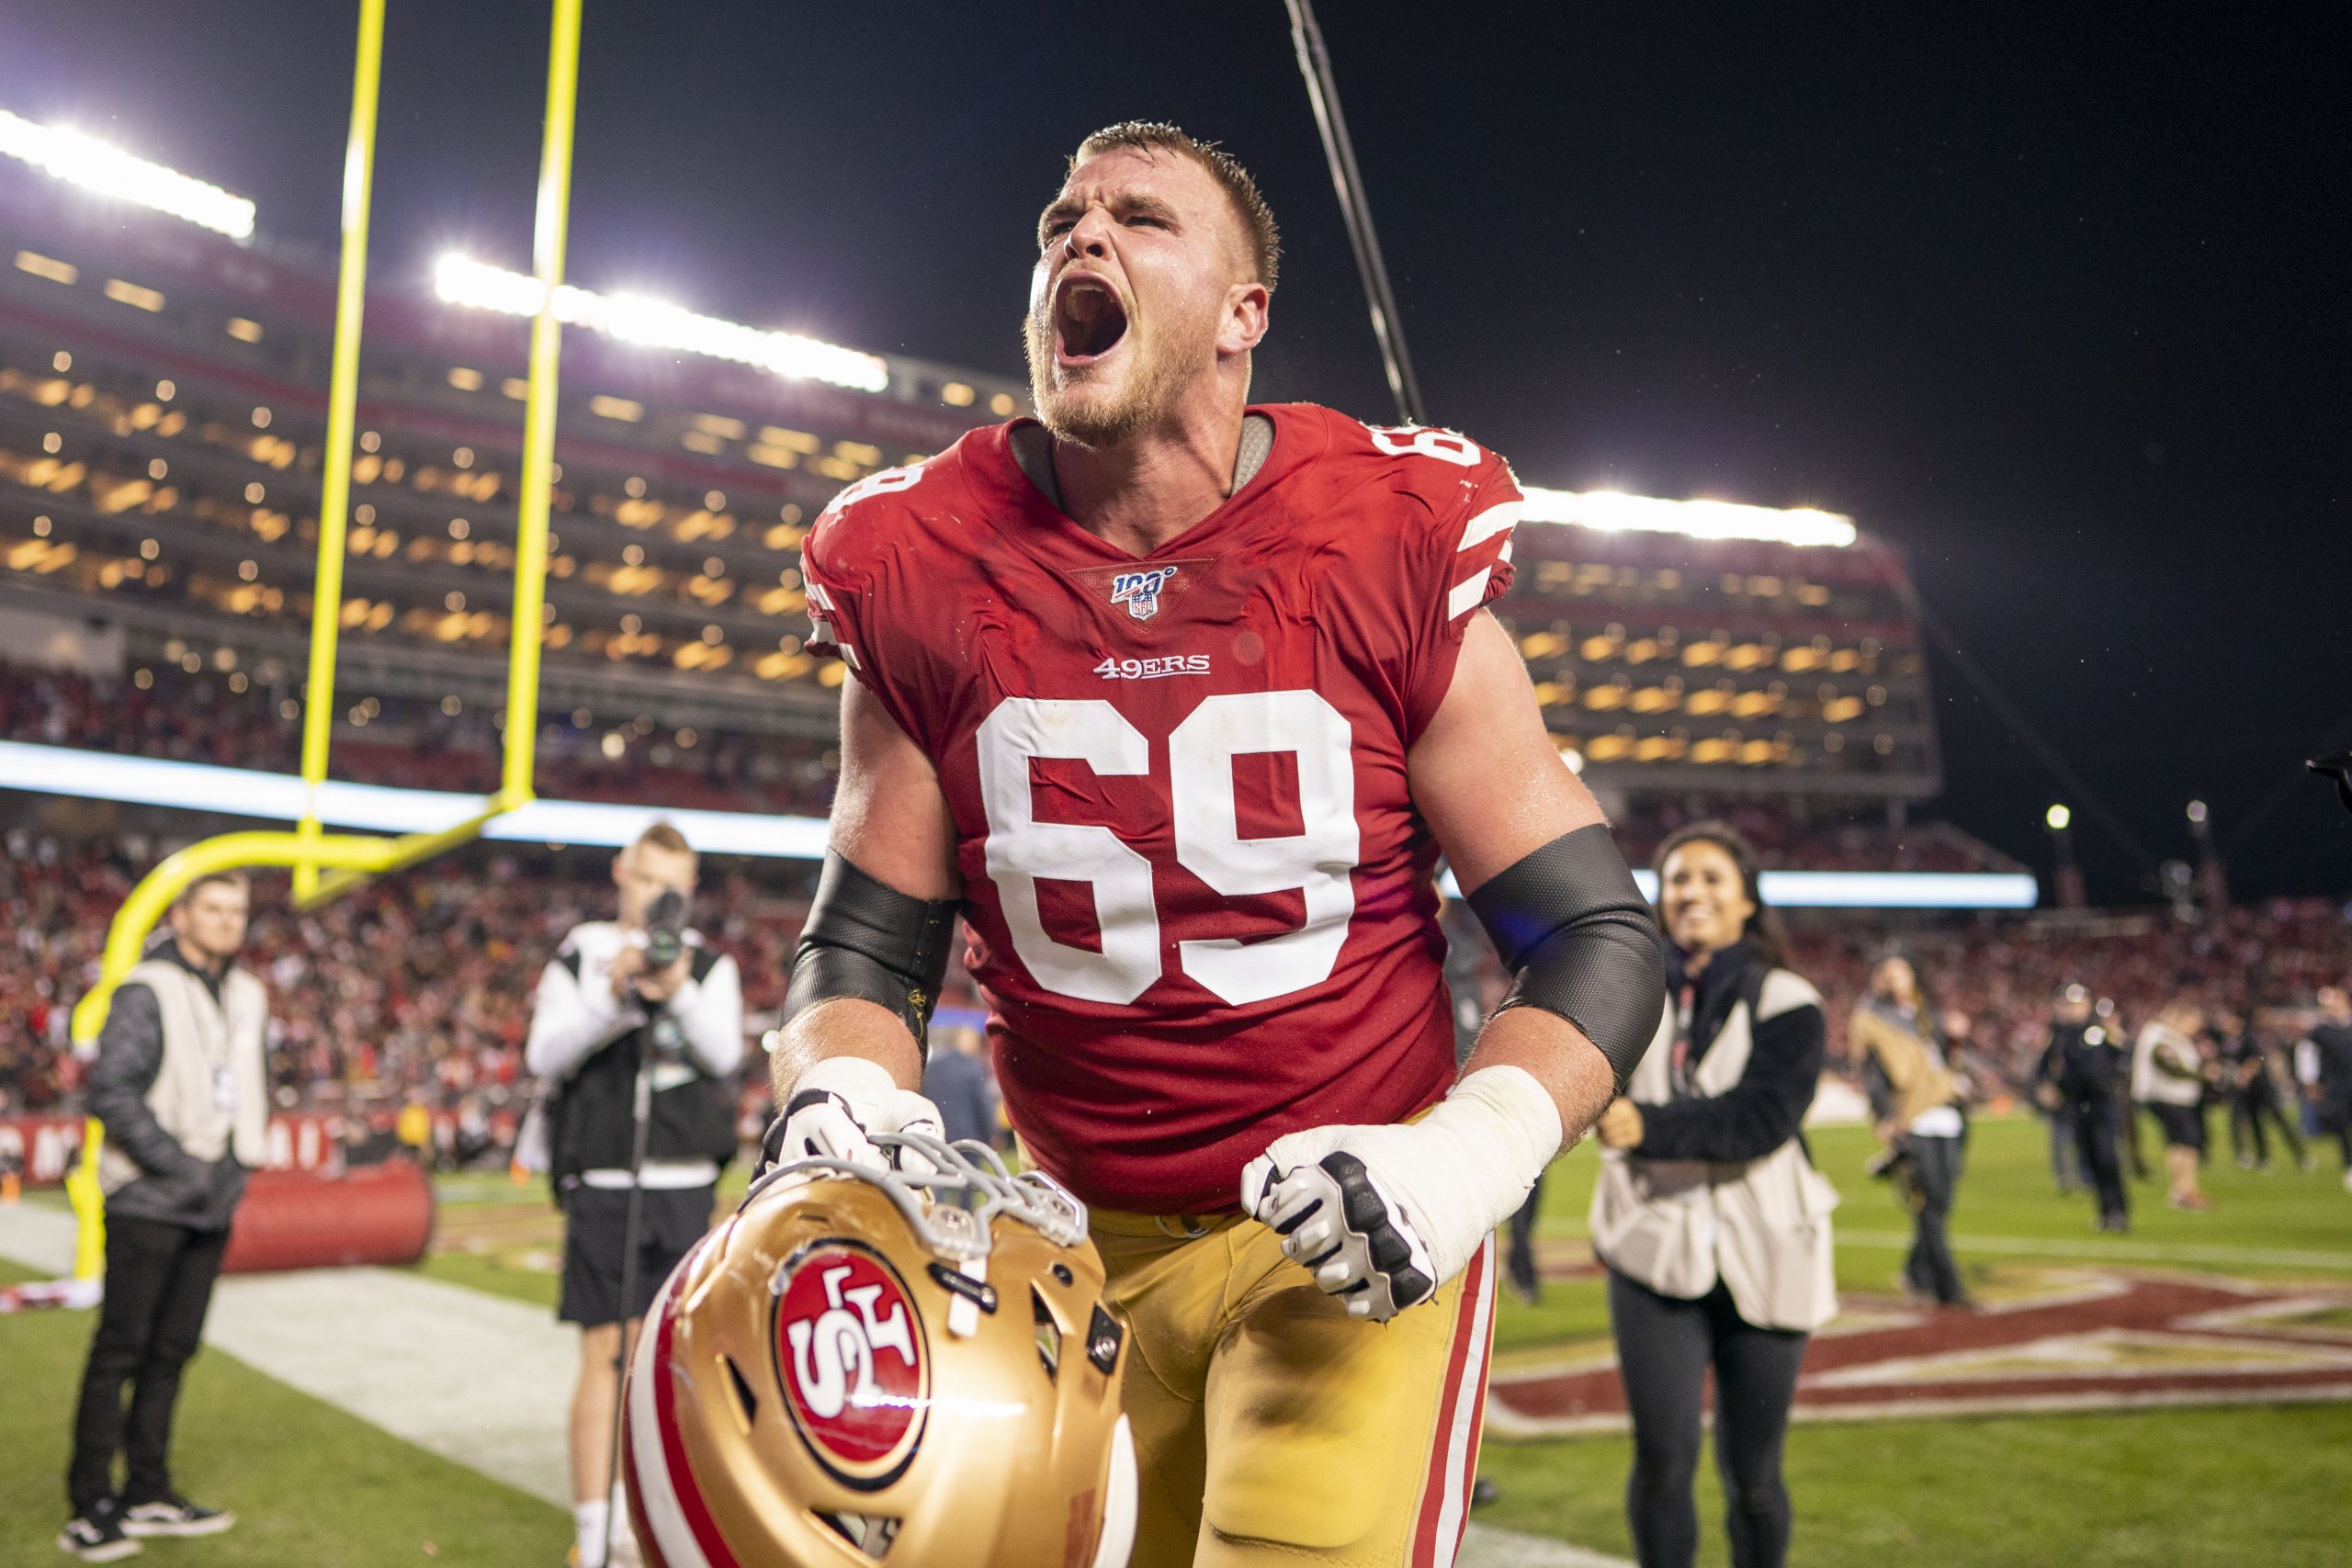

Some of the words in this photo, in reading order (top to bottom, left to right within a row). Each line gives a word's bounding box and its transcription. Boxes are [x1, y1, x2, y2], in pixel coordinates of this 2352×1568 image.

[1133, 601, 1153, 615] NFL
[1093, 655, 1210, 680] 49ERS
[976, 689, 1360, 1007] 69
